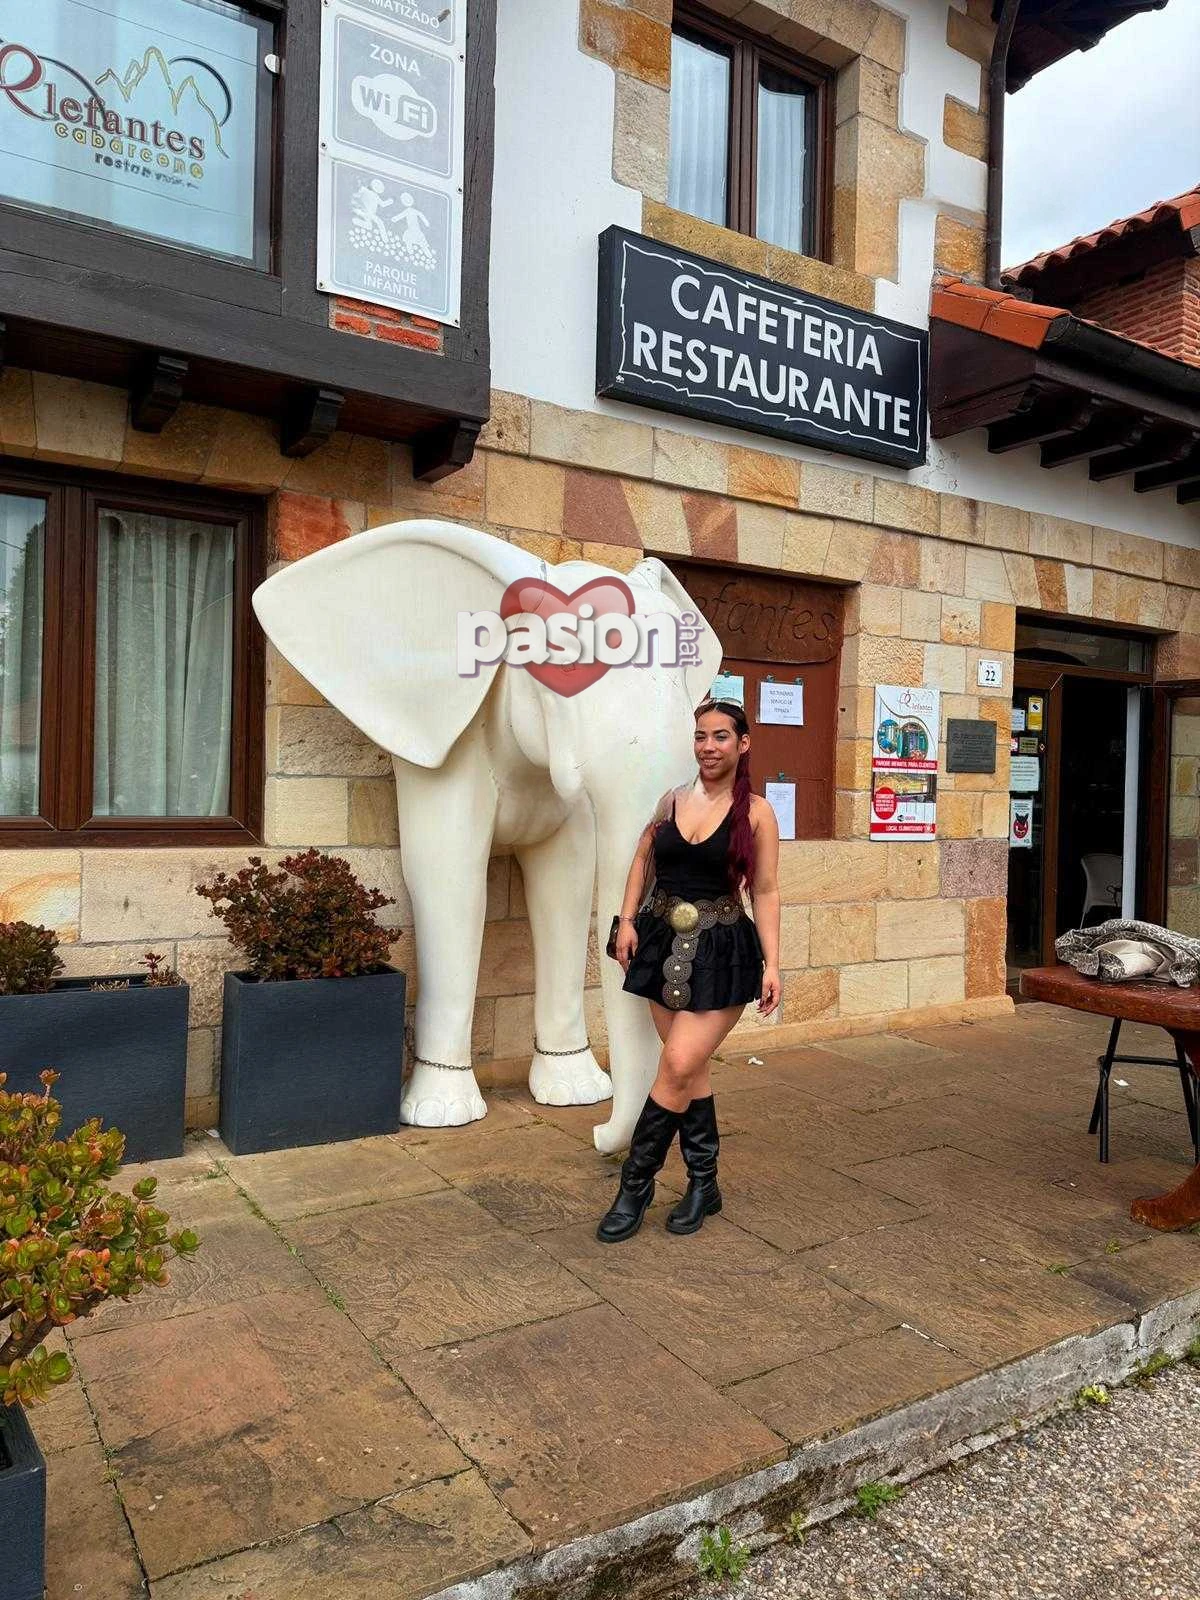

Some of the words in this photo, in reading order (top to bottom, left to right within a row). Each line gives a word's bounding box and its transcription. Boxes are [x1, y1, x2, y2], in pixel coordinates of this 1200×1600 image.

[369, 43, 421, 77] ZONA
[363, 274, 419, 300] INFANTIL
[365, 261, 417, 285] PARQUE
[671, 274, 883, 376] CAFETERIA
[633, 322, 910, 437] RESTAURANTE
[985, 670, 996, 681] 22
